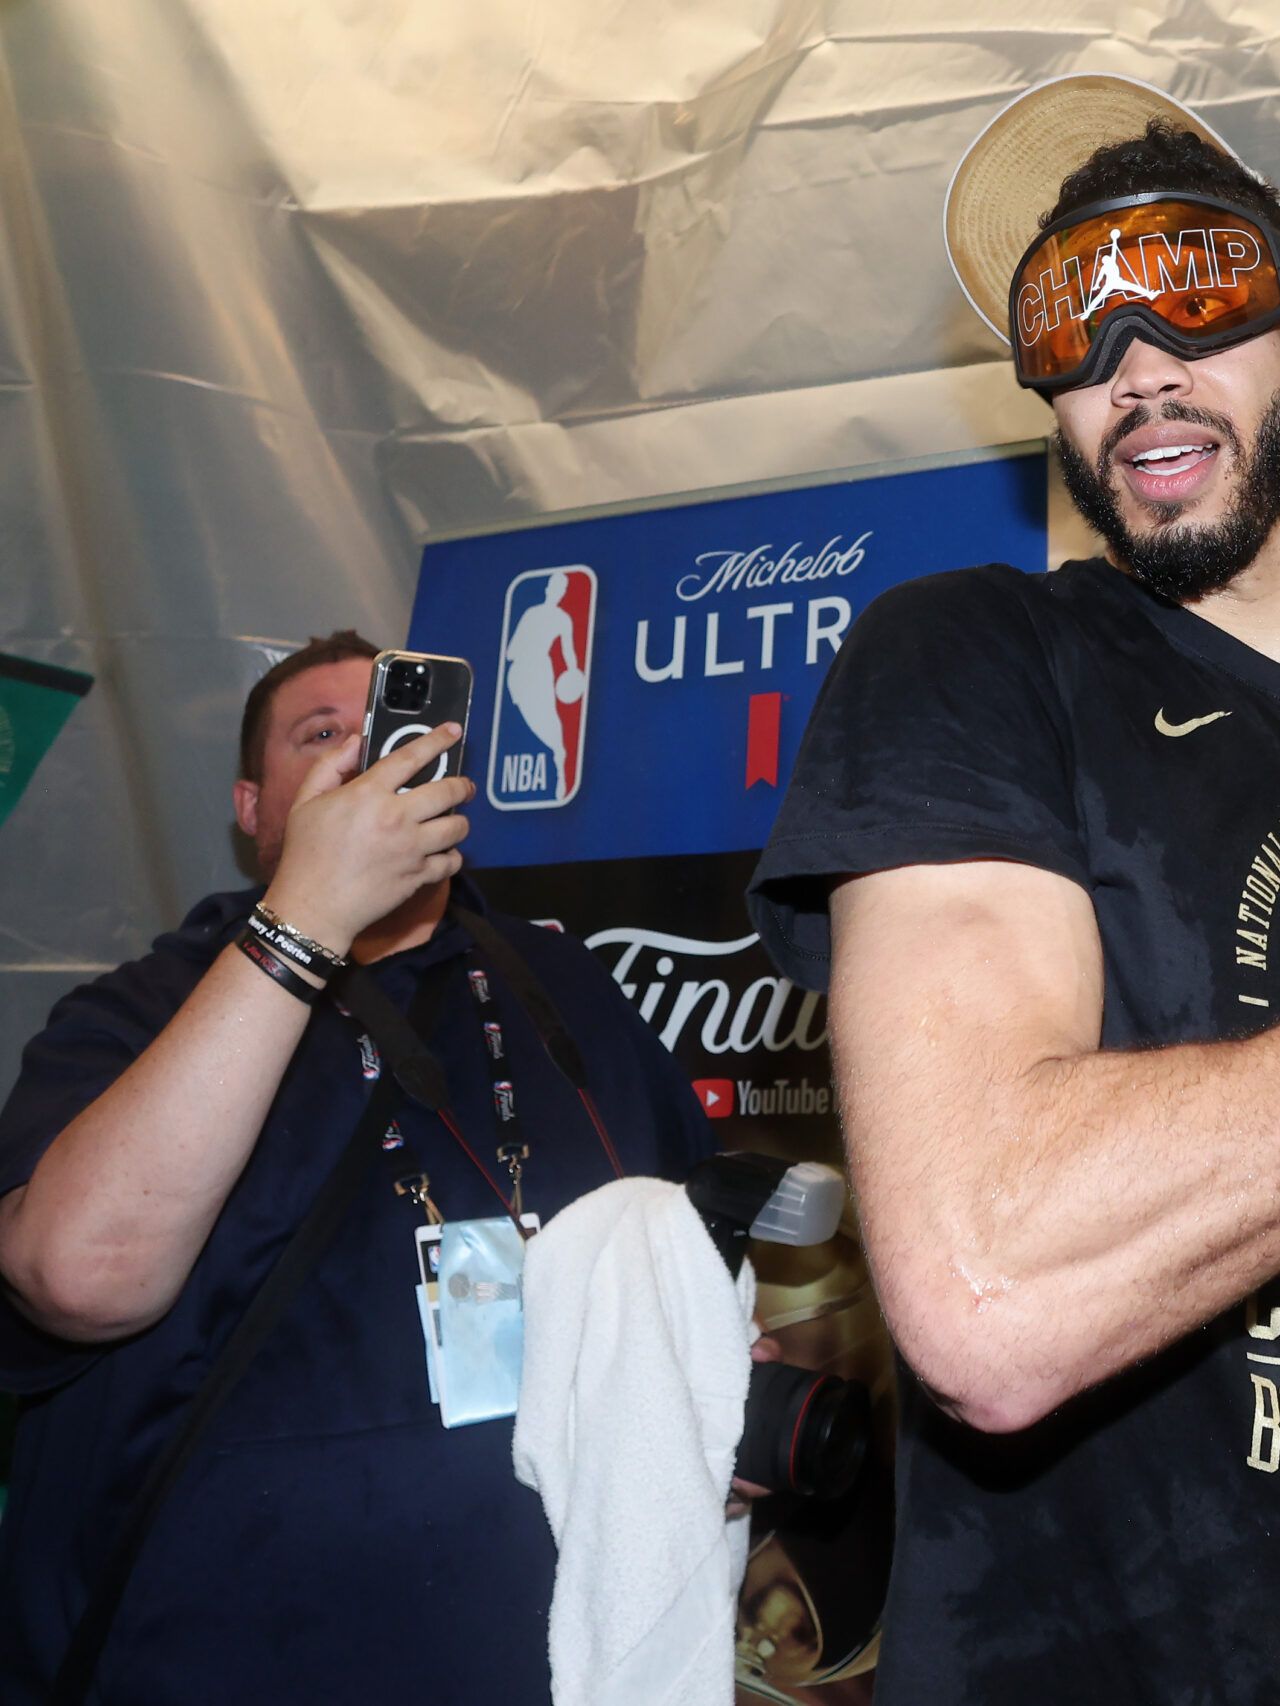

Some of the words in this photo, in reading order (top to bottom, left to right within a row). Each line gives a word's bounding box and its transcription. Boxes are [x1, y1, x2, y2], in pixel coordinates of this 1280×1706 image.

[1017, 229, 1260, 346] CHAMP
[677, 531, 873, 601] Michelob
[501, 753, 547, 794] NBA
[248, 915, 268, 936] enry
[275, 935, 312, 965] Poorten
[737, 1079, 828, 1116] YouTube
